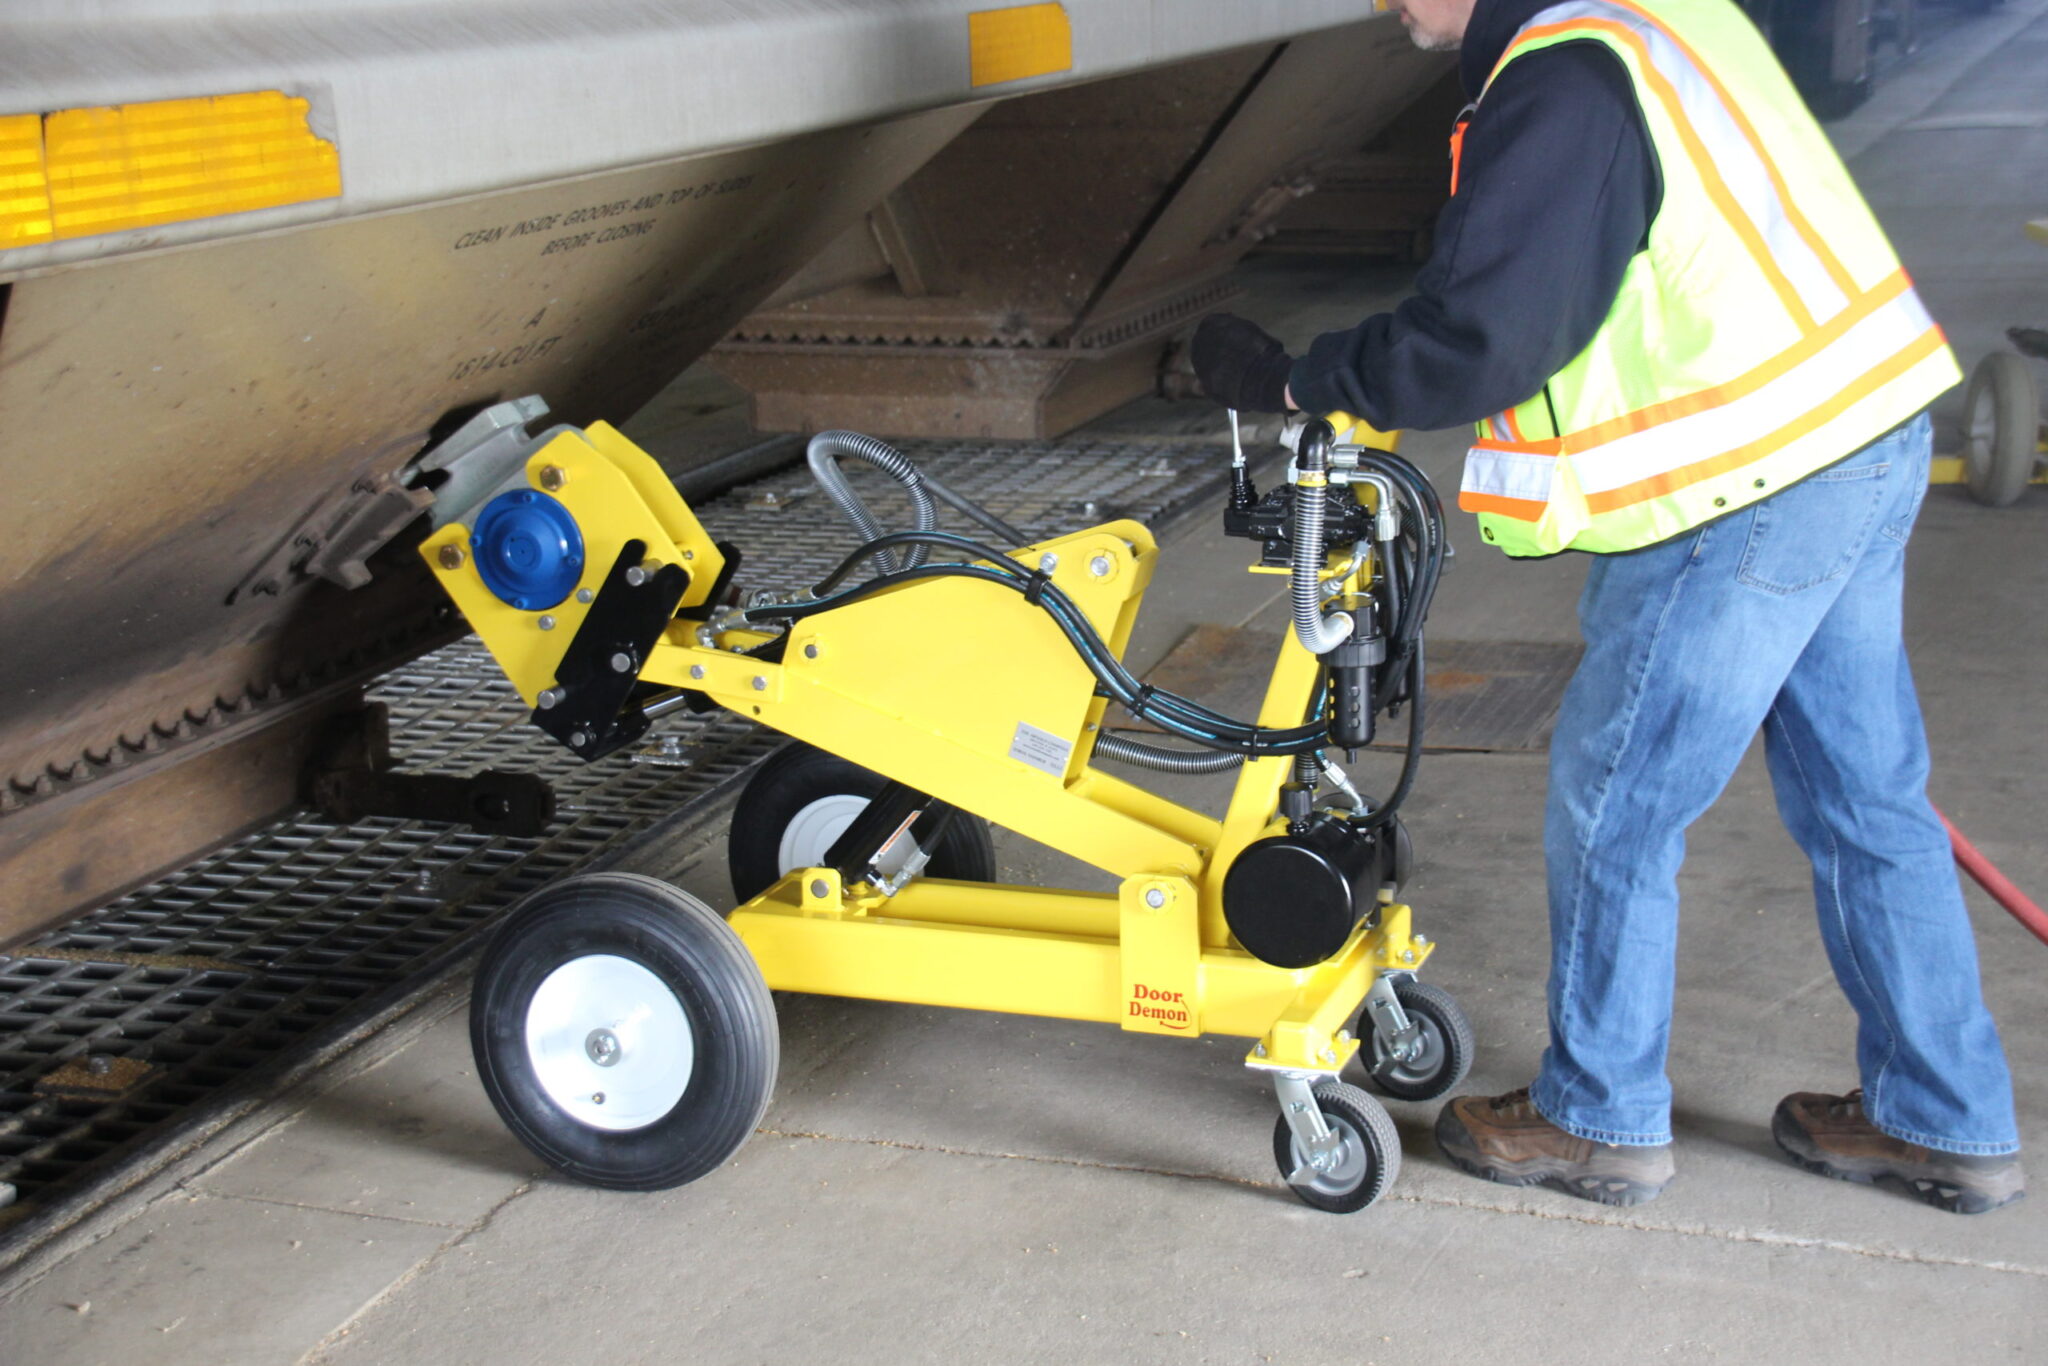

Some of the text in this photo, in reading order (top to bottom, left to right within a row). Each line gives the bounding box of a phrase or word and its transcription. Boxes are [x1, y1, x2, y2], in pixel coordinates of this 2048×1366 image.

[454, 226, 508, 250] CLEAN
[509, 214, 562, 239] INSIDE
[563, 200, 627, 227] GROOVES
[629, 193, 665, 214] AND
[540, 218, 657, 256] BEFORE CLOSING
[1133, 983, 1184, 1003] Door
[1129, 1001, 1188, 1022] Demon
